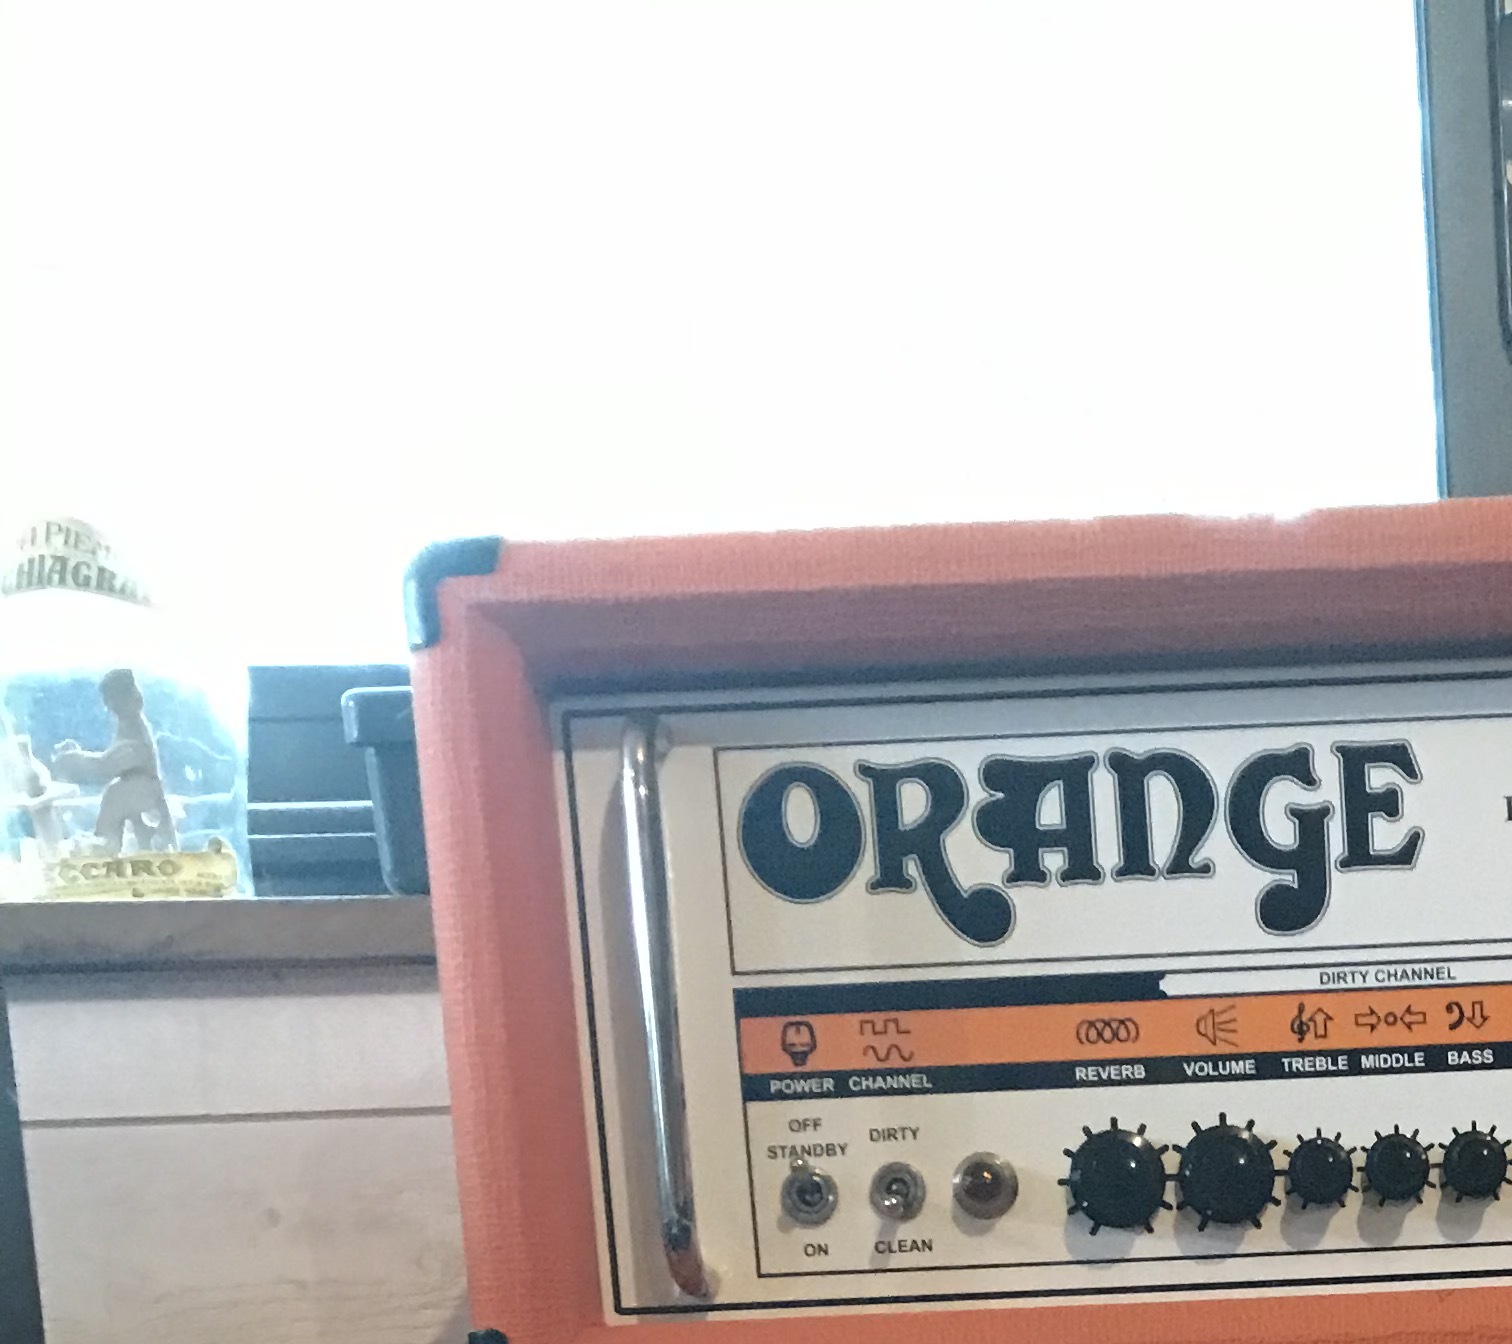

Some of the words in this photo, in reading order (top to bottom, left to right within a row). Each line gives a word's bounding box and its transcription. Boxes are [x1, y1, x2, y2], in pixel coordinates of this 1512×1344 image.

[737, 739, 1424, 947] ORANGE
[1319, 969, 1369, 986] DIRTY
[1374, 966, 1456, 983] CHANNEL
[1281, 1055, 1349, 1072] TREBLE
[1360, 1052, 1425, 1069] MIDDLE
[1447, 1048, 1494, 1065] BASS
[1075, 1063, 1146, 1082] REVERB
[1183, 1059, 1256, 1076] VOLUME
[769, 1077, 835, 1094] POWER
[848, 1073, 933, 1091] CHANNEL
[788, 1117, 823, 1133] OFF
[868, 1126, 920, 1142] DIRTY
[767, 1142, 849, 1160] STANDBY
[803, 1243, 829, 1257] ON
[874, 1238, 934, 1254] CLEAN
